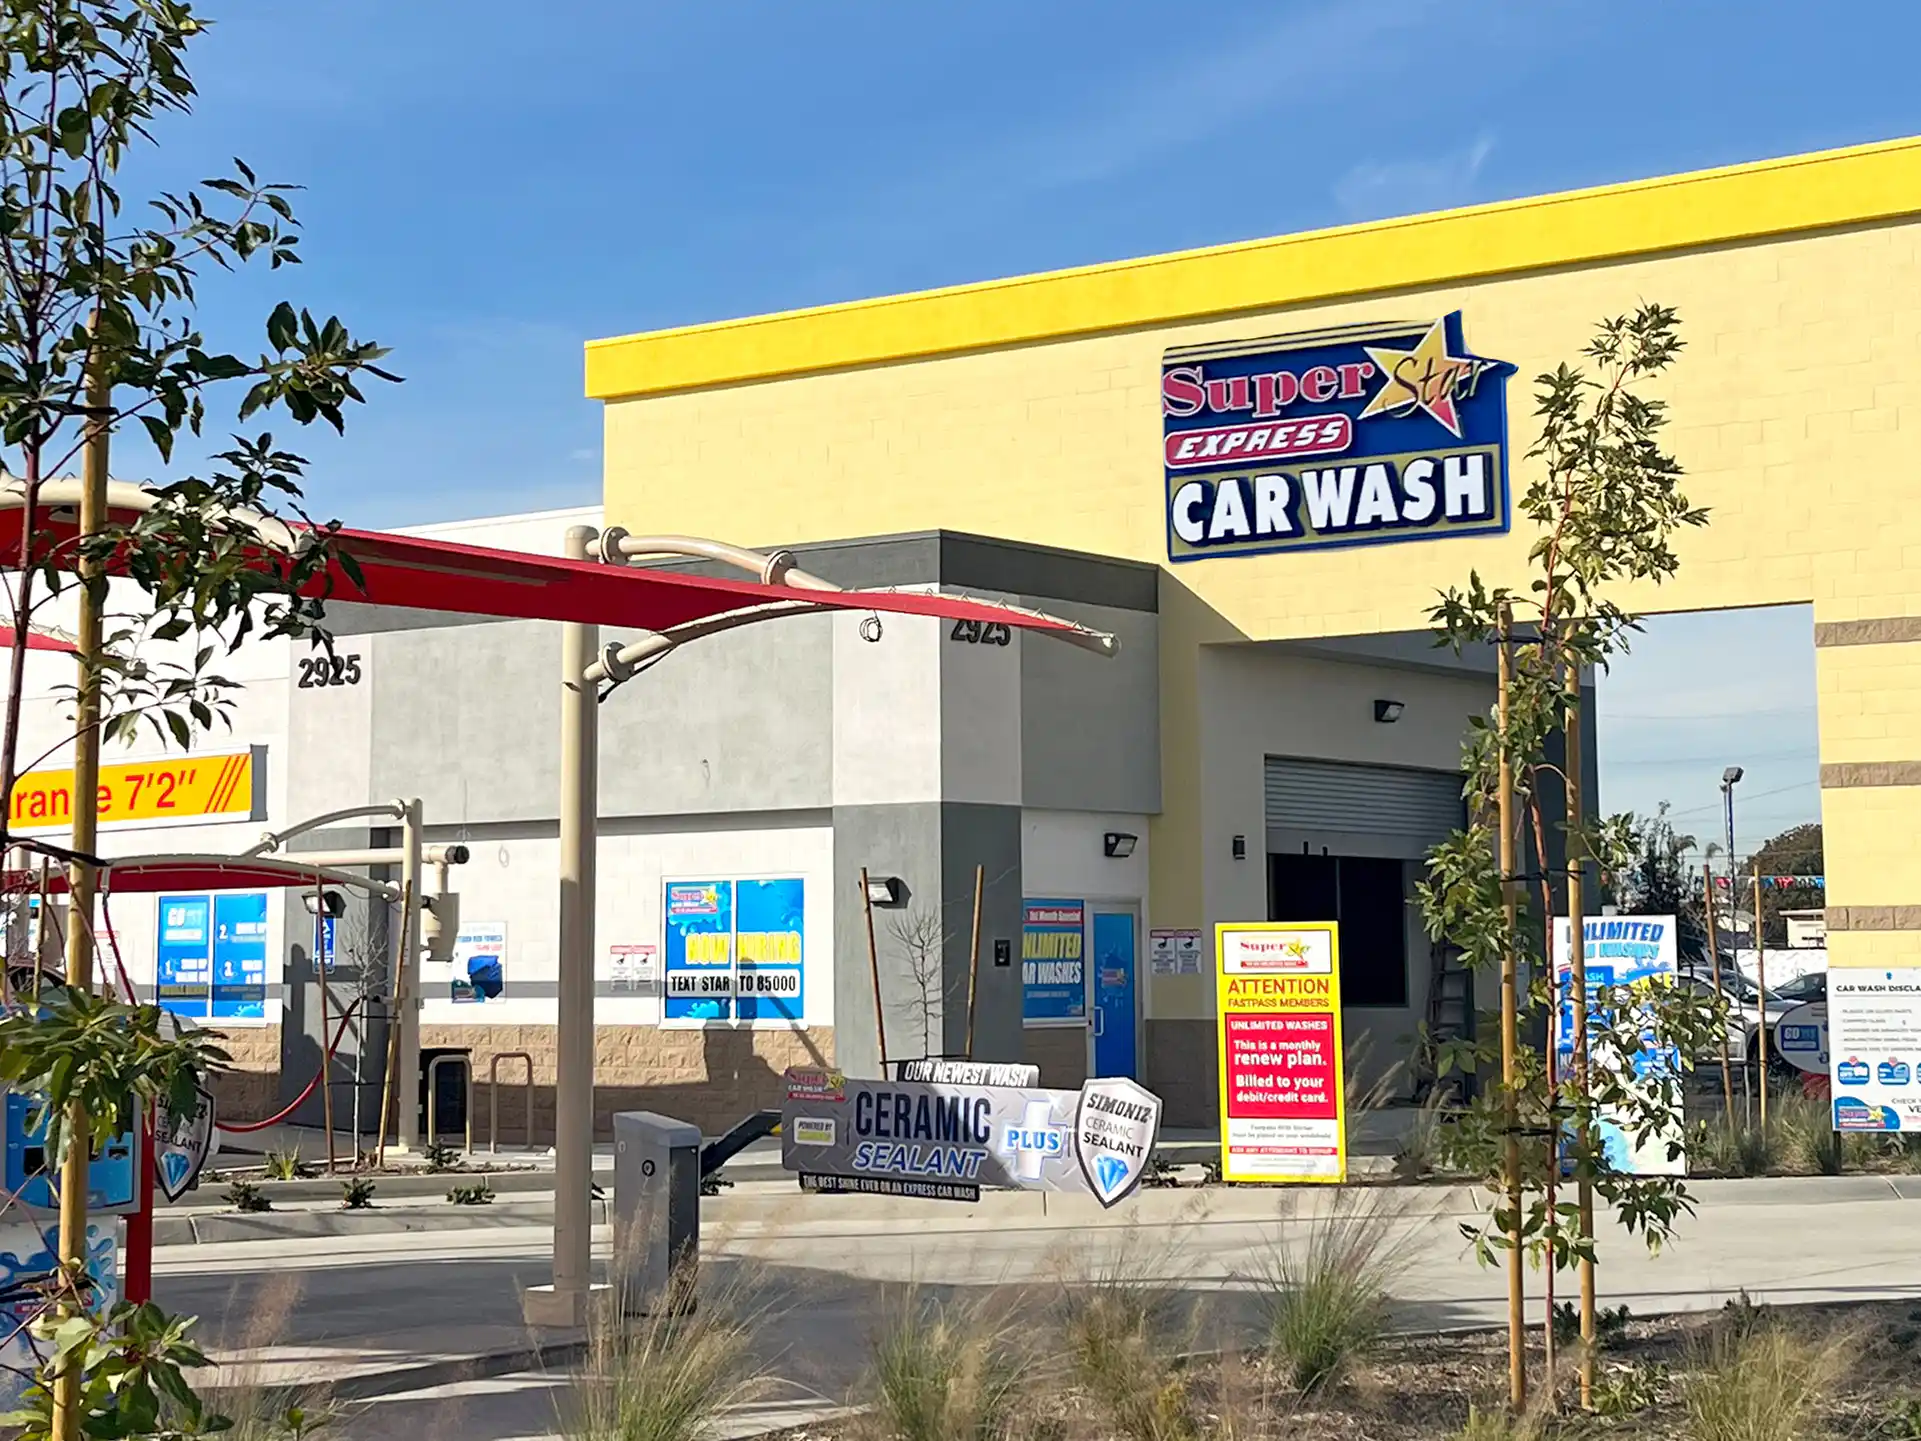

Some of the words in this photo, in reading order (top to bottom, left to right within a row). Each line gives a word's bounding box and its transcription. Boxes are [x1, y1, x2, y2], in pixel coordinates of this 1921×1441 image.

[1162, 361, 1375, 418] Super
[1382, 357, 1490, 418] Star
[1175, 420, 1345, 460] EXPRESS
[1172, 474, 1293, 542] CAR
[1301, 455, 1486, 529] WASH
[951, 619, 1011, 646] 2925
[298, 653, 361, 688] 2925
[9, 785, 112, 819] rane
[1022, 932, 1081, 959] NLIMITED
[1240, 942, 1287, 952] Super
[671, 975, 696, 991] TEXT
[702, 975, 730, 991] STAR
[740, 975, 753, 991] TO
[757, 975, 796, 991] 85000
[1022, 962, 1037, 985] AR
[1038, 961, 1081, 985] WASHES
[1228, 979, 1329, 994] ATTENTION
[1228, 998, 1277, 1008] FASTPASS
[1280, 998, 1329, 1008] MEMBERS
[1231, 1020, 1284, 1030] UNLIMITED
[1286, 1021, 1328, 1030] WASHES
[1234, 1040, 1256, 1050] This
[1258, 1040, 1267, 1050] is
[1279, 1040, 1321, 1052] monthly
[1234, 1053, 1283, 1065] renew
[1287, 1050, 1328, 1069] plan.
[905, 1061, 933, 1081] OUR
[933, 1061, 988, 1085] NEWEST
[989, 1066, 1030, 1087] WASH
[1235, 1074, 1273, 1087] Billed
[1276, 1075, 1290, 1087] to
[1293, 1077, 1324, 1091] your
[1086, 1092, 1152, 1123] SIMONIZ
[1237, 1091, 1300, 1103] debit/credit
[1300, 1092, 1329, 1103] card.
[855, 1091, 991, 1144] CERAMIC
[1085, 1116, 1135, 1140] CERAMIC
[155, 1130, 202, 1153] SELANT
[1006, 1130, 1060, 1151] PLUS
[1083, 1131, 1144, 1158] SEALANT
[852, 1141, 988, 1179] SEALANT
[803, 1175, 817, 1188] THE
[819, 1176, 837, 1188] BEST
[838, 1177, 859, 1191] SHINE
[861, 1179, 879, 1192] EVER
[880, 1181, 890, 1193] ON
[903, 1183, 936, 1197] EXPRESS
[937, 1184, 953, 1197] CAR
[954, 1186, 976, 1200] WASH
